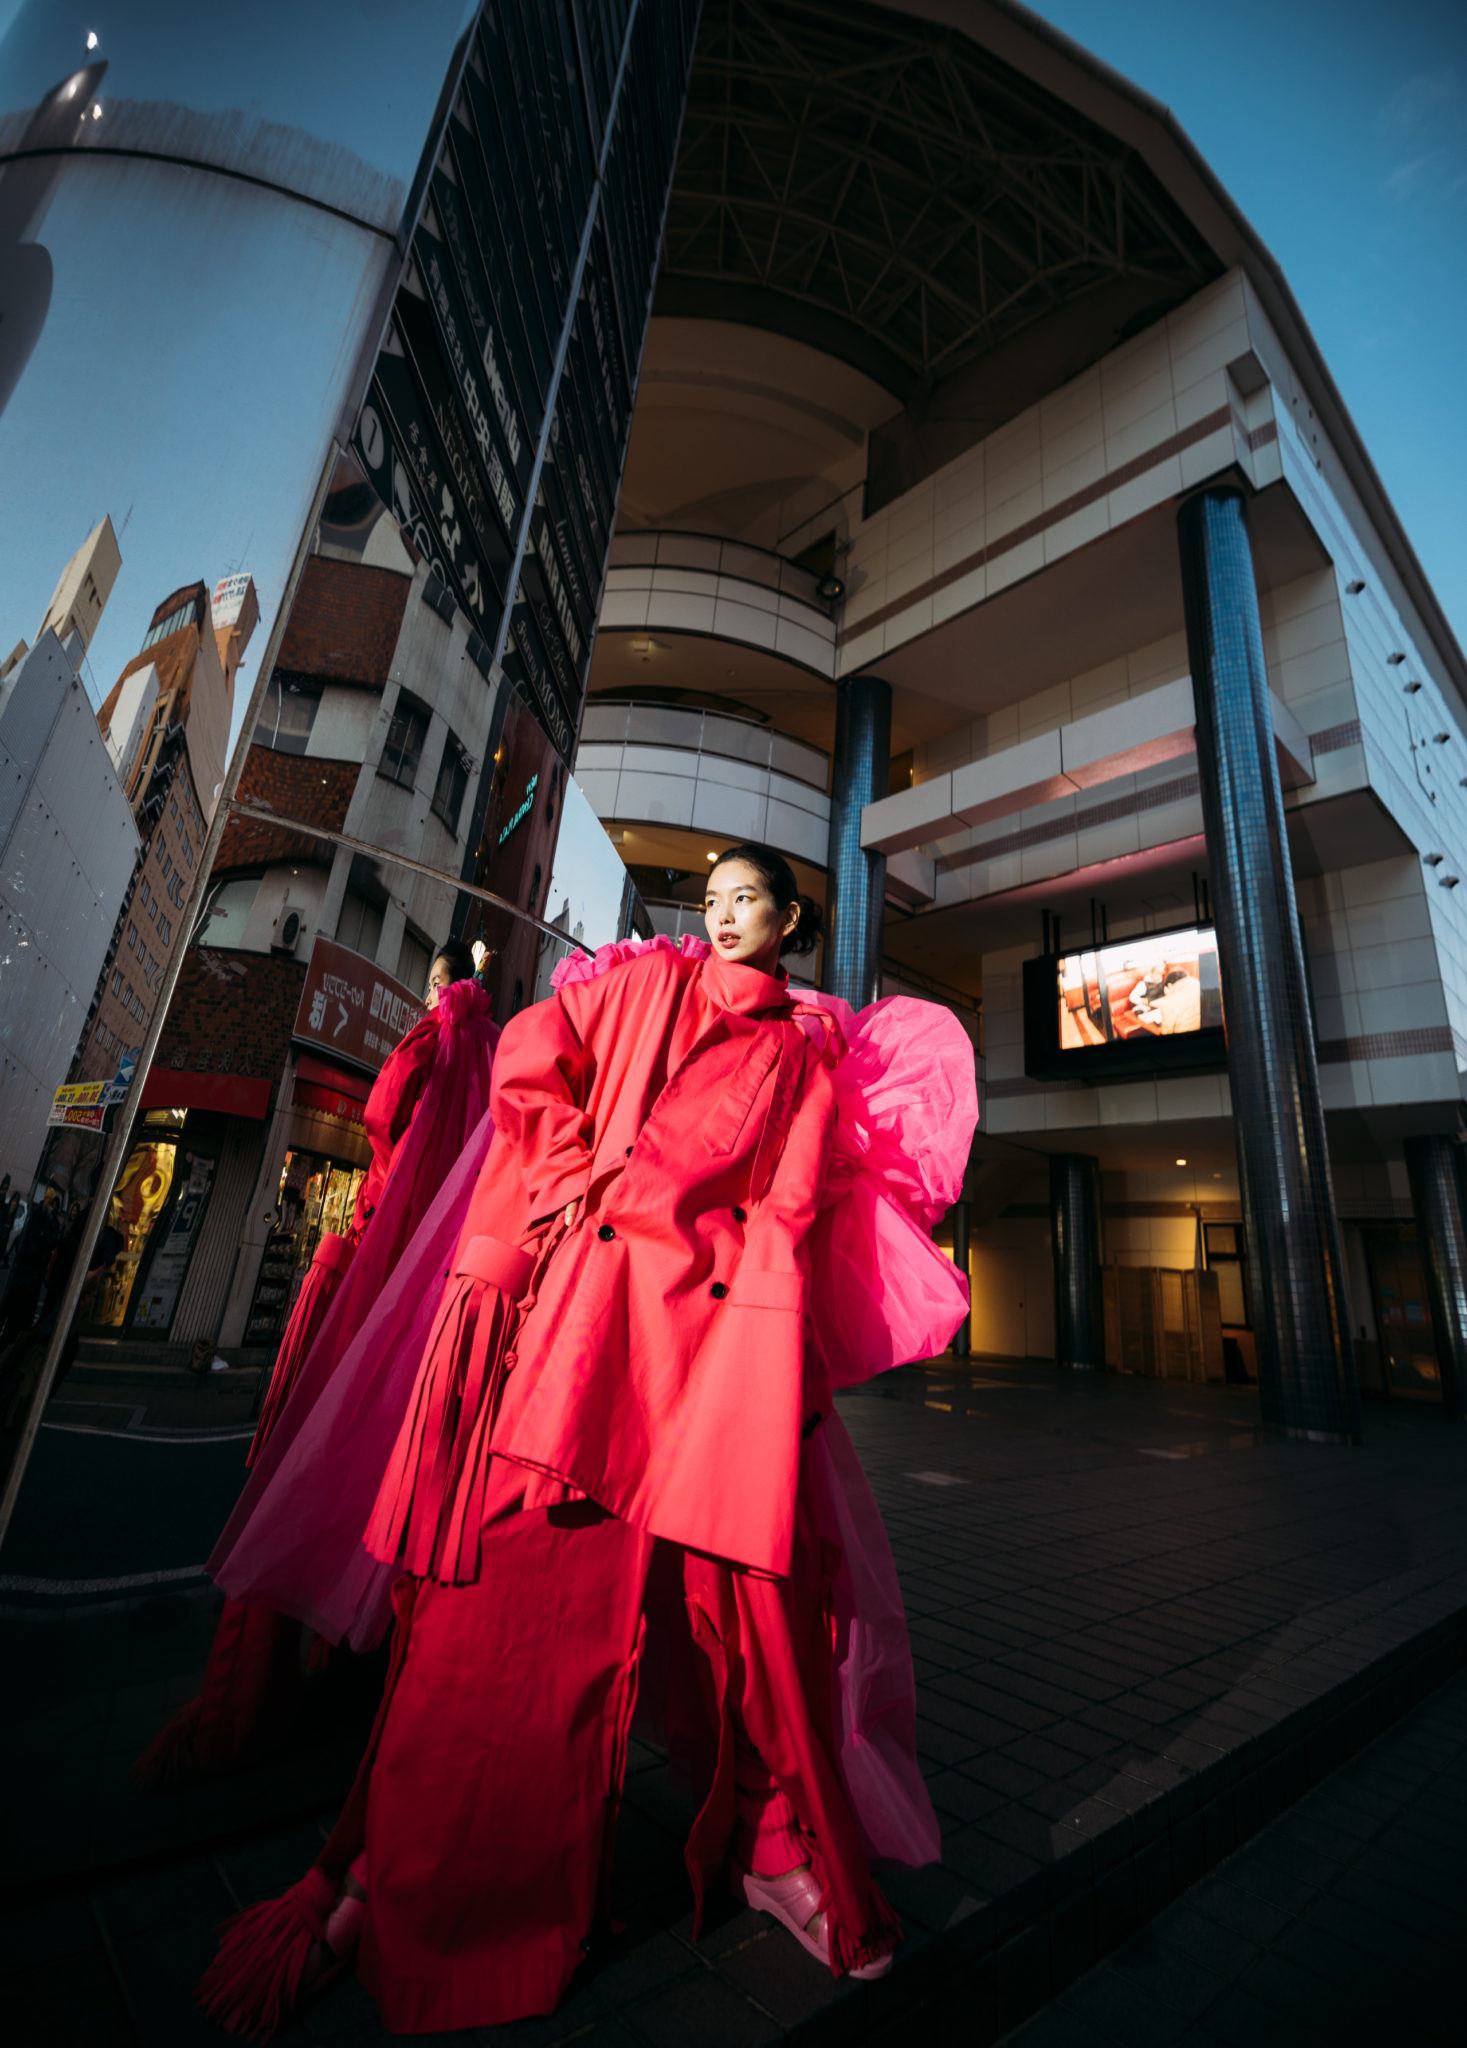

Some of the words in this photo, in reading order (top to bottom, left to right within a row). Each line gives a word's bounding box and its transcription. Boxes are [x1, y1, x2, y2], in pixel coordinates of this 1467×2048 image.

[539, 521, 560, 599] BAR
[556, 583, 580, 663] FLOW
[538, 668, 569, 754] MOMO
